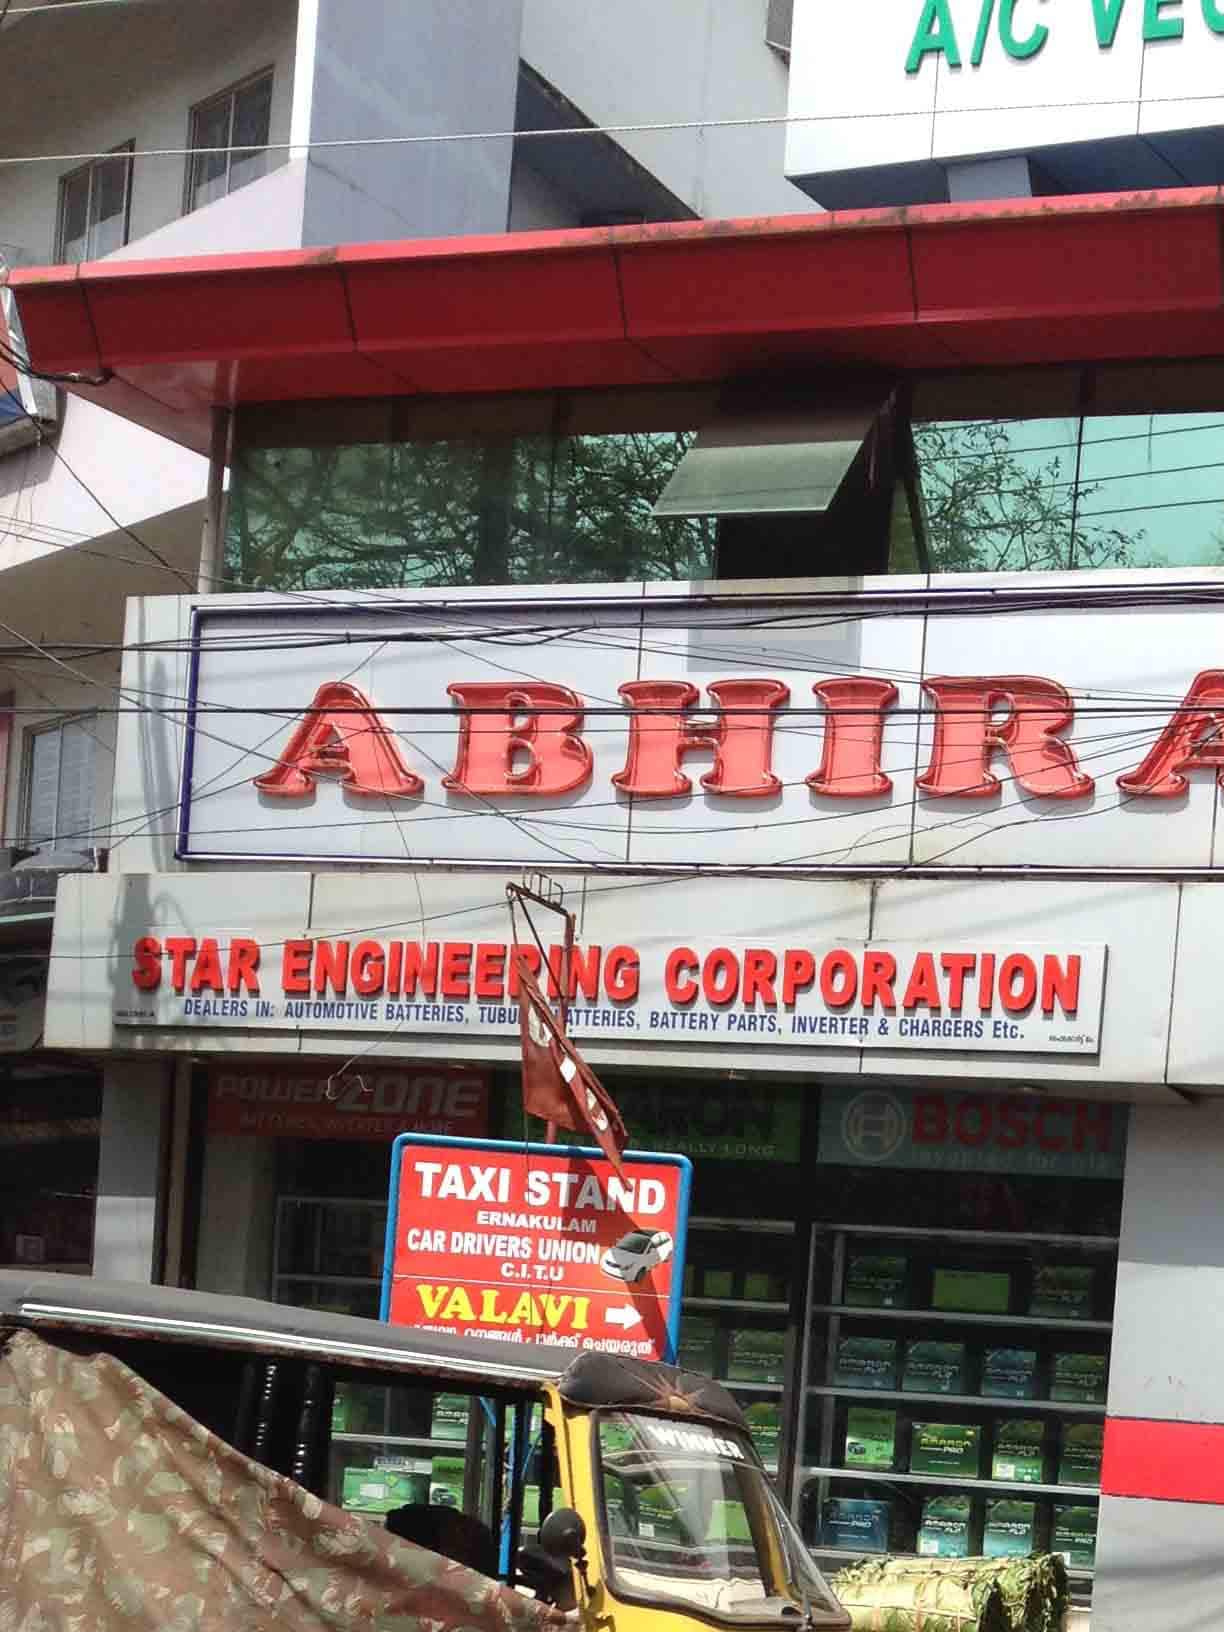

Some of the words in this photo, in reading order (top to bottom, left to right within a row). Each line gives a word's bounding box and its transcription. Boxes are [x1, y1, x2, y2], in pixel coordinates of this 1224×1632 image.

[905, 0, 1049, 73] A/C
[133, 937, 261, 992] STAR
[282, 939, 640, 1003] ENGINEERING
[665, 946, 1082, 1014] CORPORATION
[184, 998, 248, 1018] DEALERS
[255, 1000, 275, 1018] IN:
[284, 1000, 378, 1021] AUTOMOTIVE
[385, 1002, 469, 1026] BATTERIES,
[557, 1008, 641, 1032] ATTERIES,
[649, 1010, 720, 1031] BATTERY
[727, 1013, 782, 1036] PARTS,
[791, 1014, 870, 1035] INVERTER
[877, 1017, 890, 1036] &
[898, 1017, 984, 1039] CHARGERS
[992, 1019, 1025, 1040] Etc.
[912, 1097, 1113, 1153] BOSCH
[415, 1162, 509, 1203] TAXI
[524, 1170, 667, 1214] STAND
[476, 1210, 597, 1233] ERNAKULAM
[407, 1228, 445, 1253] CAR
[450, 1231, 532, 1259] DRIVERS
[538, 1238, 601, 1265] UNION
[415, 1284, 593, 1329] VALAVI
